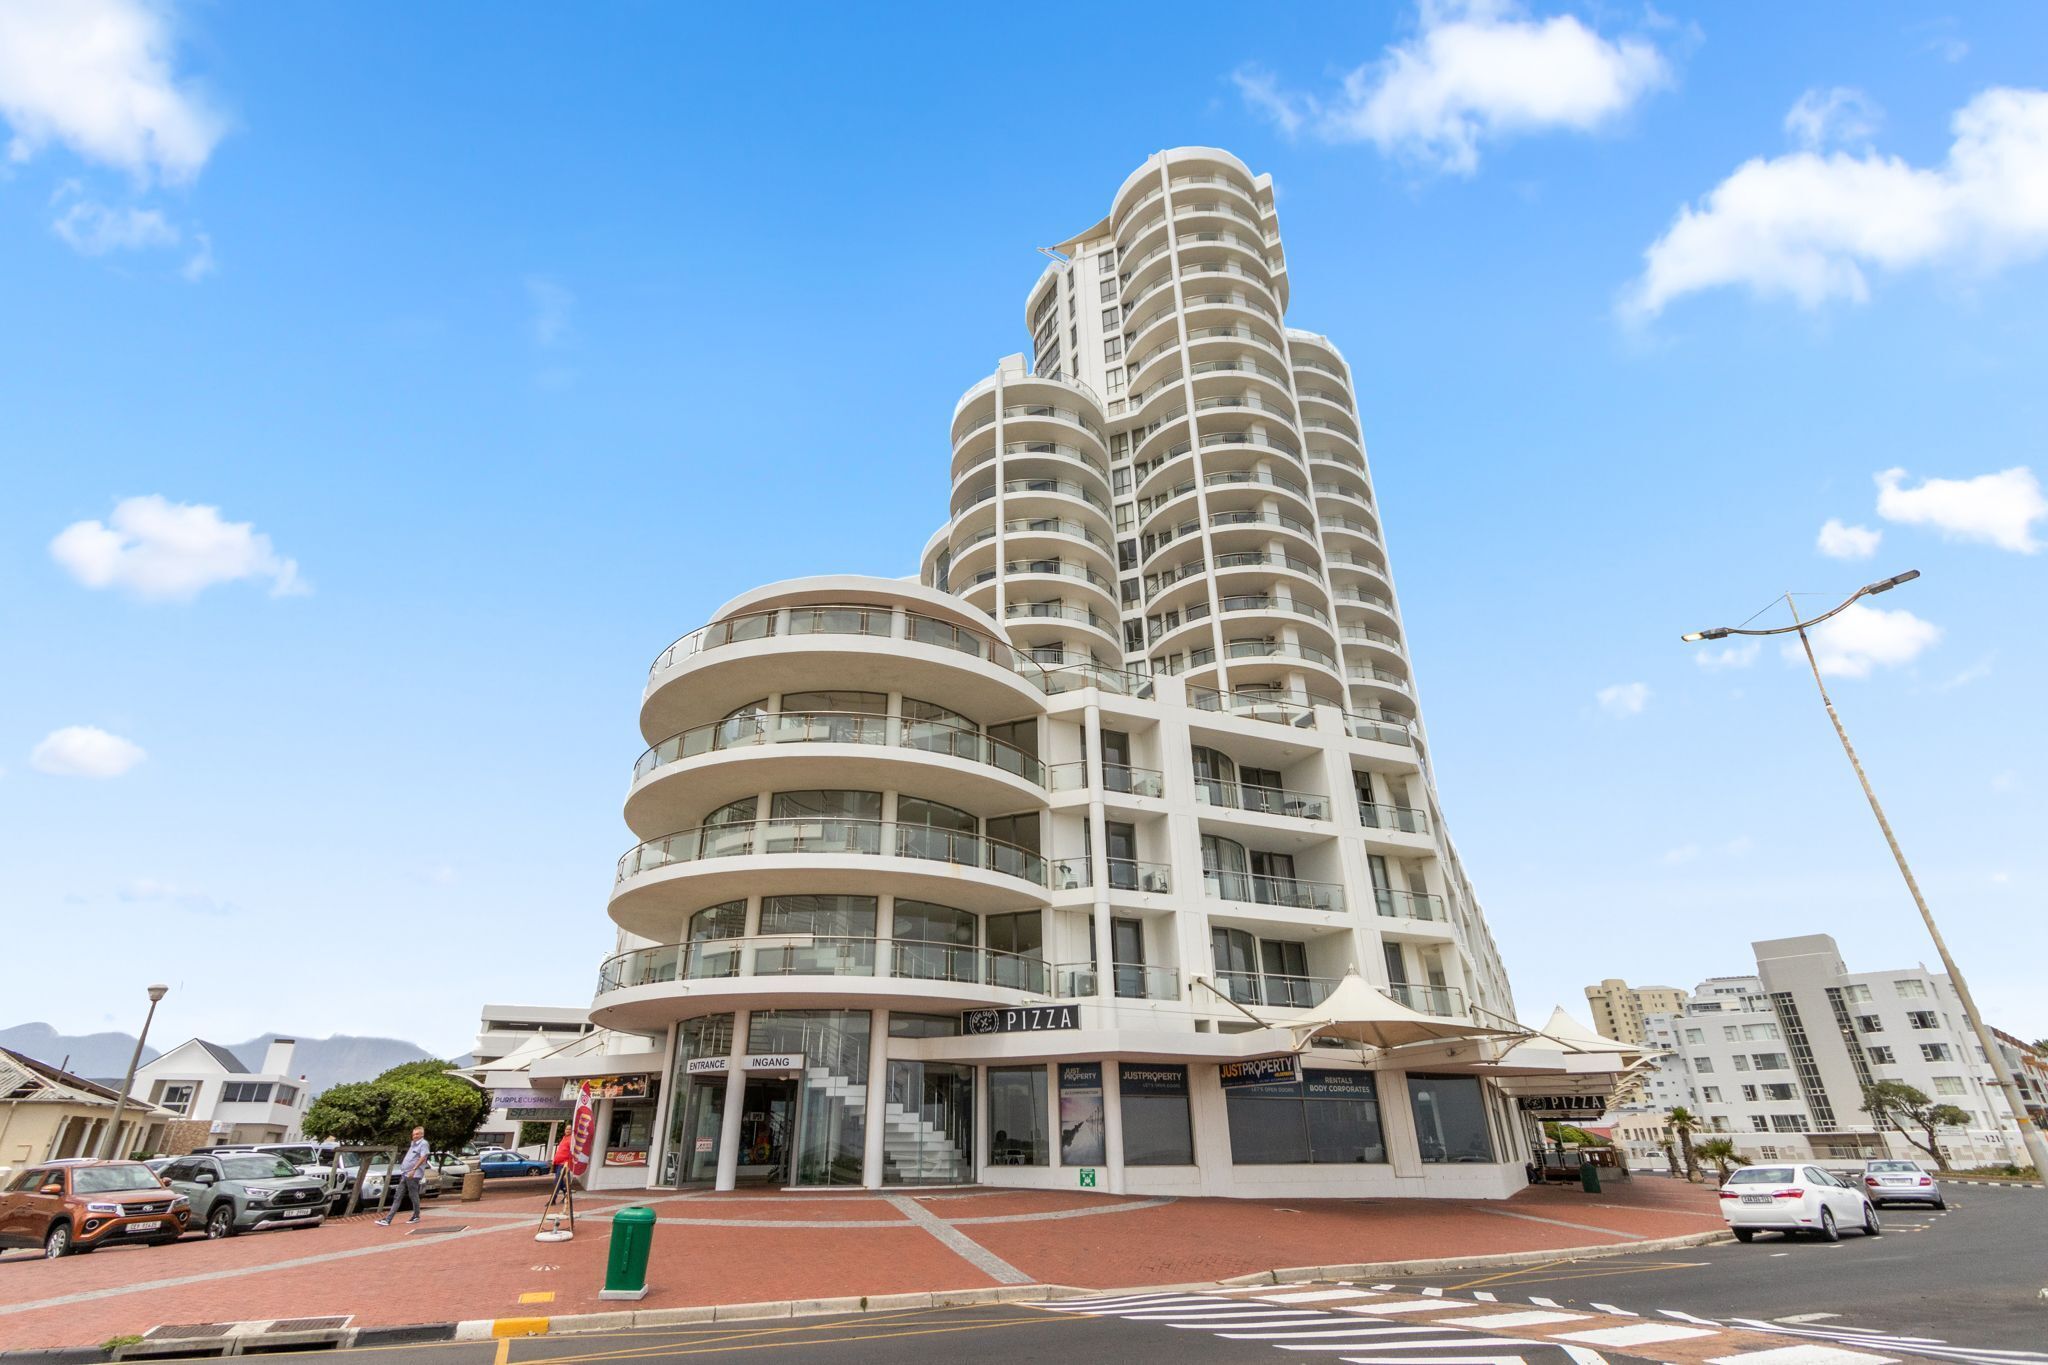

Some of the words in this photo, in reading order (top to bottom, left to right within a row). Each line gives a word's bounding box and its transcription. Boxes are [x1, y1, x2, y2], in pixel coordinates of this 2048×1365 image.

[1007, 1008, 1072, 1031] PIZZA
[689, 1059, 726, 1071] ENTRANCE
[752, 1058, 790, 1067] INGANG
[1221, 1057, 1292, 1079] JUSTPROPERTY
[1064, 1072, 1097, 1081] PROPERTY
[1122, 1071, 1182, 1083] JUSTPROPERTY
[1324, 1076, 1353, 1084] RENTALS
[1309, 1084, 1328, 1092] BODY
[1328, 1085, 1370, 1093] CORPORATES
[1551, 1096, 1601, 1109] PIZZA
[1985, 1134, 2000, 1143] 121
